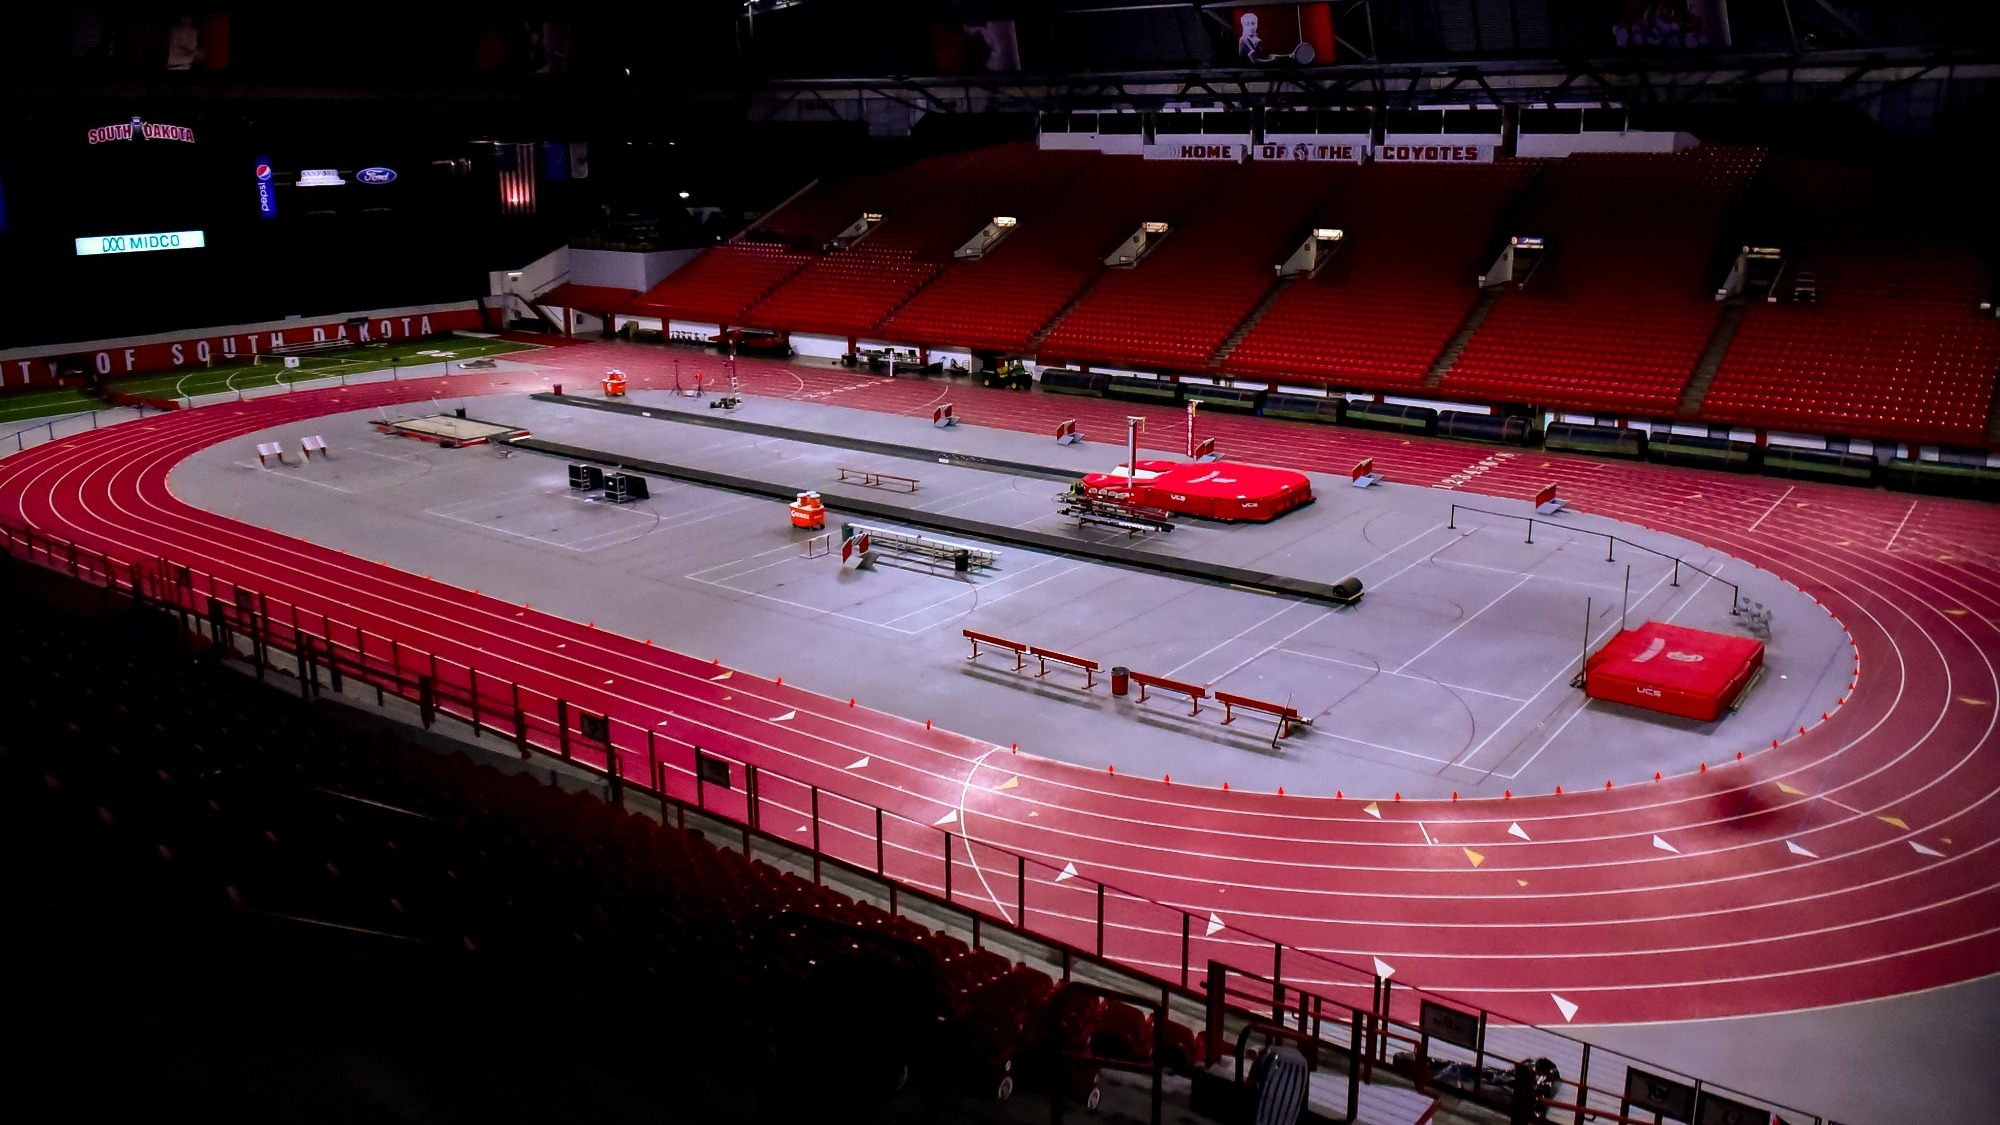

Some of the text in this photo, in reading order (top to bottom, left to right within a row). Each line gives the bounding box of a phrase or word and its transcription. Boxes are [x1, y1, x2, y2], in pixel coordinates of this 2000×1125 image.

[88, 124, 195, 145] SOUTH DAKOTA
[1181, 146, 1286, 159] HOME OF
[1318, 146, 1352, 159] THE
[1382, 147, 1478, 161] COYOTES
[363, 169, 390, 181] Ford
[257, 182, 270, 212] pepsi
[130, 234, 180, 249] MIDCO
[96, 348, 136, 375] OF
[171, 332, 284, 366] SOUTH
[312, 315, 432, 346] DAKOTA
[1637, 687, 1661, 697] UCS
